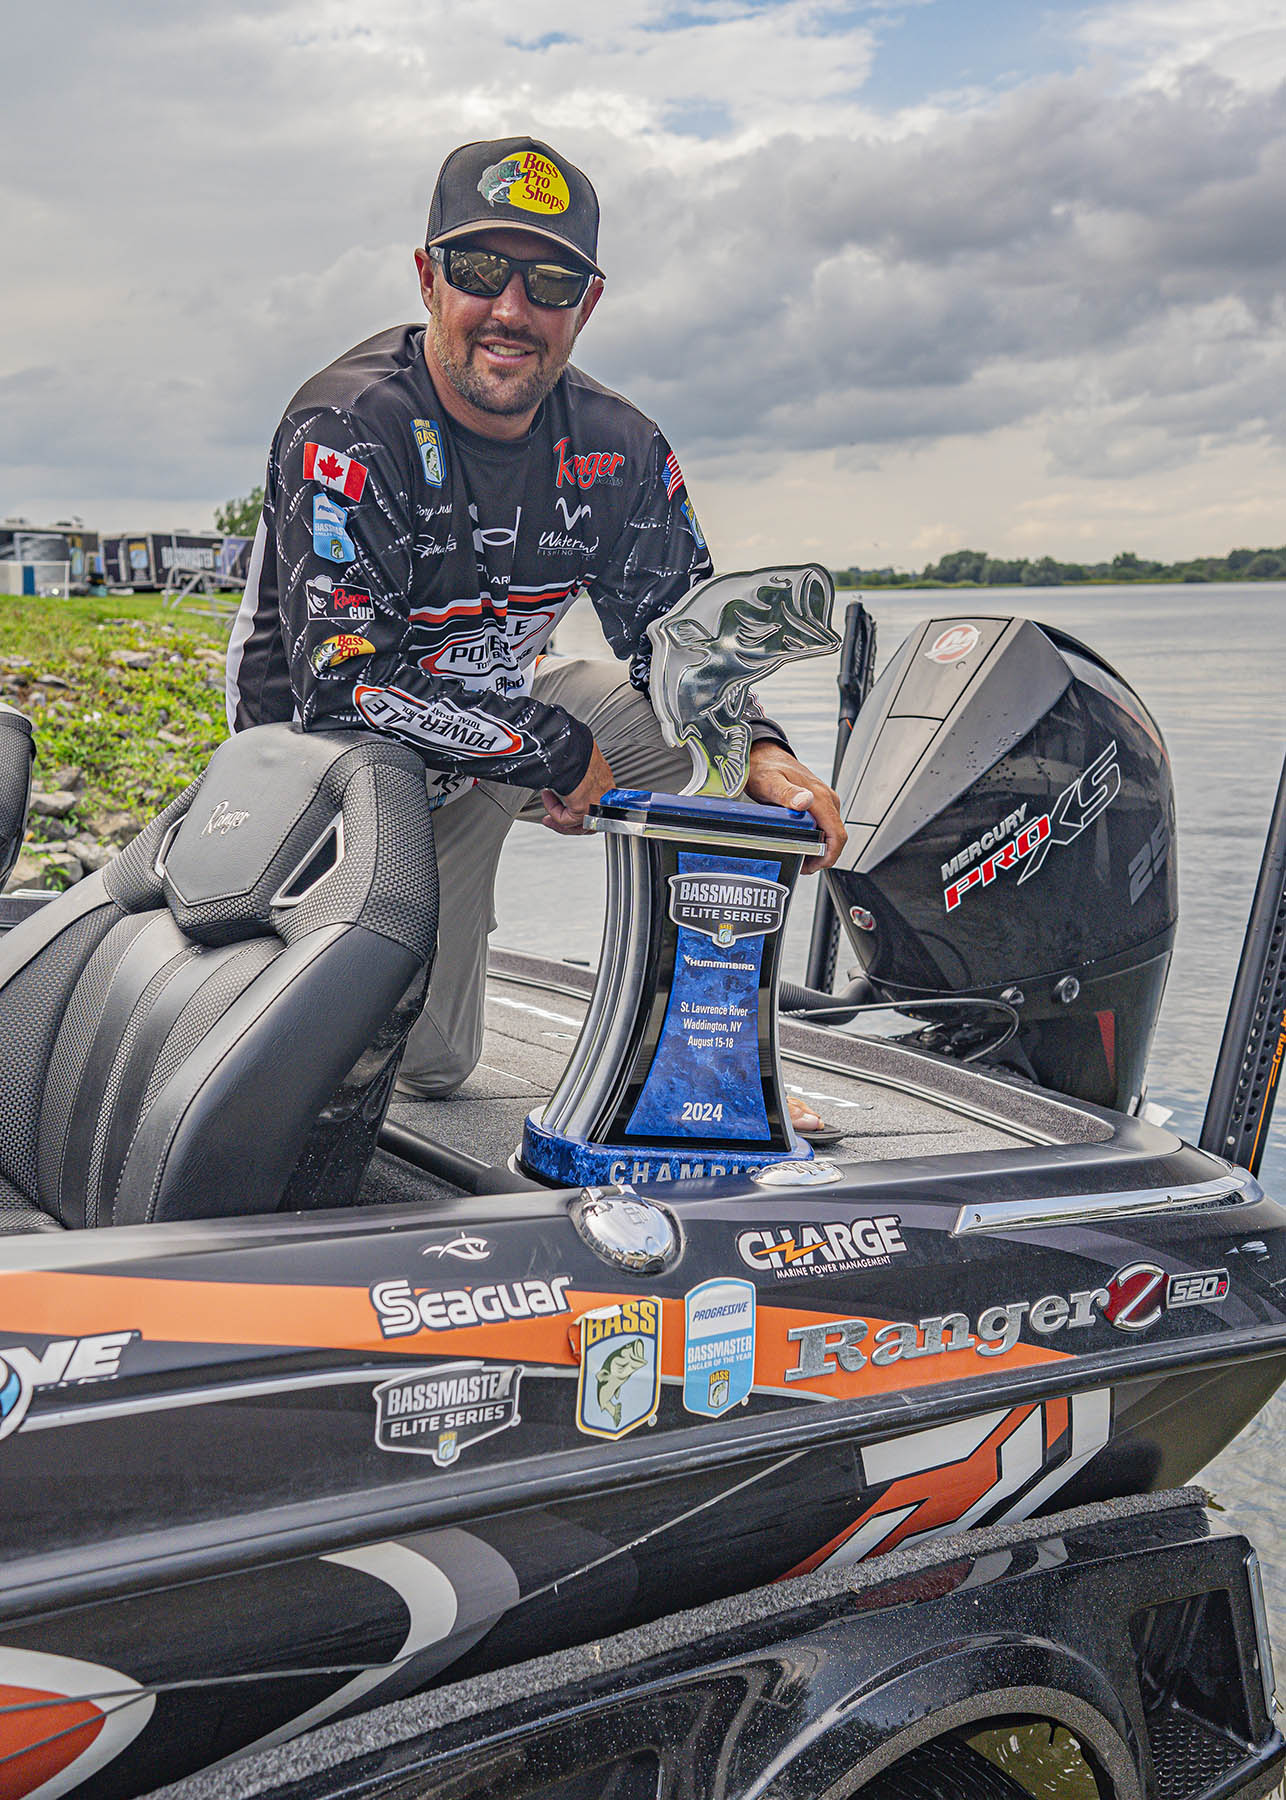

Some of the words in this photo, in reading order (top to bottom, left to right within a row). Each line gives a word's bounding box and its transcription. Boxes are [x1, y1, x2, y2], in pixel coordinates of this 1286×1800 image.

[523, 152, 558, 179] Bass
[524, 170, 550, 189] Pro
[522, 184, 567, 212] Shops
[553, 435, 625, 490] Rnger
[348, 606, 373, 619] CUP
[337, 634, 364, 647] Bass
[338, 646, 360, 657] Pro
[457, 714, 482, 731] TOTAL
[200, 799, 251, 838] Ranger
[942, 813, 1051, 913] PRO
[1016, 740, 1122, 886] XS
[941, 802, 1028, 882] MERCURY
[679, 881, 778, 908] BASSMASTER
[682, 906, 720, 920] ELITE
[723, 910, 772, 924] SERIES
[680, 1001, 690, 1013] St.
[691, 1002, 728, 1015] Lawrence
[729, 1005, 749, 1017] River
[683, 1018, 729, 1033] Waddington,
[730, 1021, 743, 1033] NY
[687, 1035, 714, 1049] August
[714, 1037, 734, 1049] 15-18
[681, 1101, 723, 1122] 2024
[738, 1216, 908, 1271] CHARGE
[776, 1266, 809, 1279] MARINE
[810, 1262, 838, 1275] POWER
[839, 1255, 892, 1272] MANAGEMENT
[692, 1301, 750, 1322] PROGRESSIVE
[586, 1301, 656, 1347] BASS
[784, 1287, 1110, 1382] Ranger
[687, 1335, 753, 1364] BASSMASTER
[687, 1359, 713, 1372] ANGLER
[713, 1358, 721, 1367] OF
[723, 1355, 735, 1364] THE
[736, 1351, 752, 1361] YEAR
[709, 1370, 729, 1384] BASS
[390, 1416, 440, 1438] ELITE
[444, 1405, 505, 1429] SERIES
